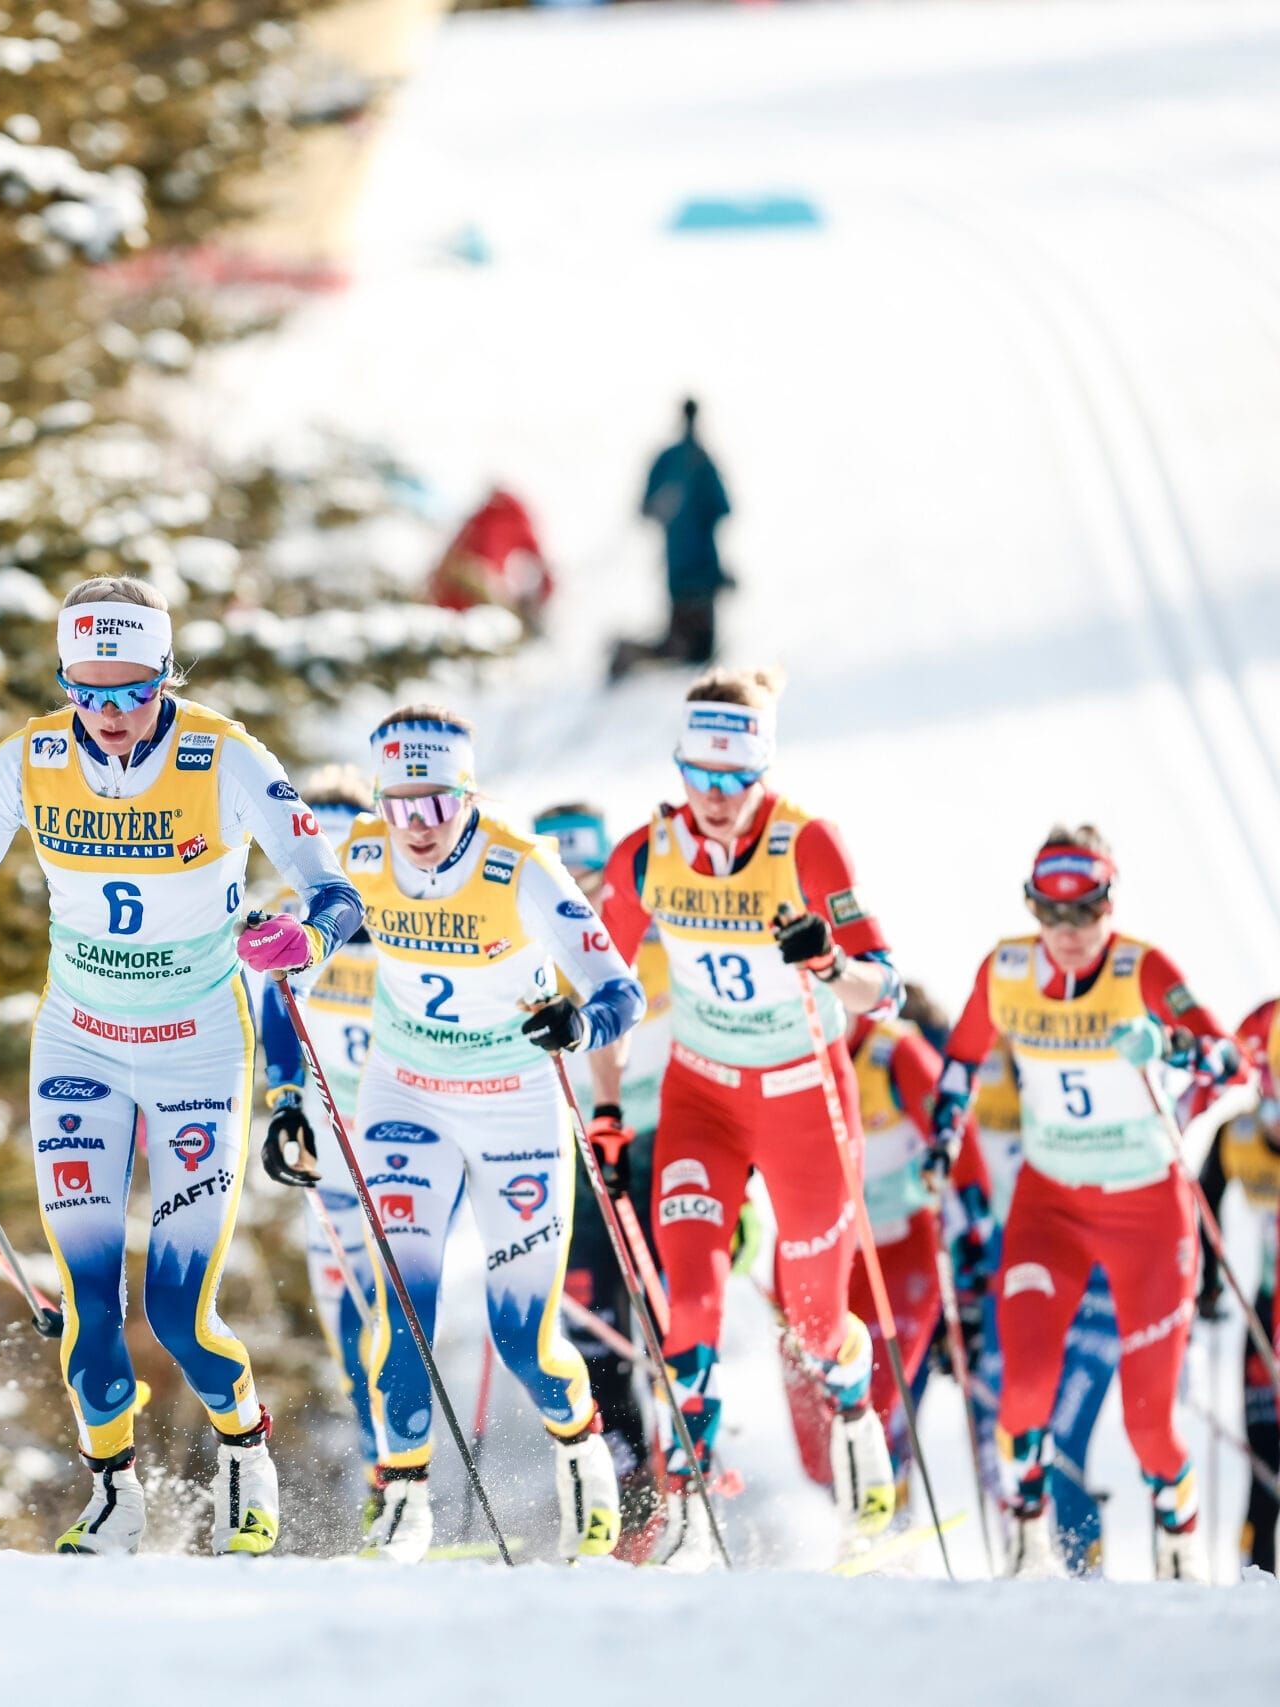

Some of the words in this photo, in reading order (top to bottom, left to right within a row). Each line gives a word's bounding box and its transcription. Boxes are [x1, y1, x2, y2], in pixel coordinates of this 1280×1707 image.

[96, 618, 145, 631] SVENSKA
[96, 626, 122, 636] SPEL
[404, 742, 451, 753] SVENSKA
[404, 751, 431, 760] SPEL
[178, 753, 212, 766] coop
[34, 805, 60, 835] LE
[292, 813, 324, 837] IC
[42, 836, 168, 857] SWITZERLAND
[484, 864, 512, 880] coop
[102, 881, 144, 935] 6
[365, 905, 377, 927] E
[77, 942, 174, 969] CANMORE
[65, 953, 192, 980] explorecanmore.ca
[696, 952, 755, 1002] 13
[420, 973, 459, 1023] 2
[74, 1008, 197, 1044] BAUHAUS
[1058, 1070, 1093, 1118] 5
[156, 1098, 226, 1113] Sundström
[375, 1122, 424, 1141] Ford
[38, 1137, 106, 1153] SCANIA
[169, 1137, 202, 1149] Thermia
[481, 1149, 555, 1162] Sundström
[366, 1173, 431, 1189] SCANIA
[45, 1199, 88, 1212] SVENSKA
[90, 1196, 112, 1206] SPEL
[152, 1177, 217, 1228] CRAFT
[487, 1225, 551, 1271] CRAFT
